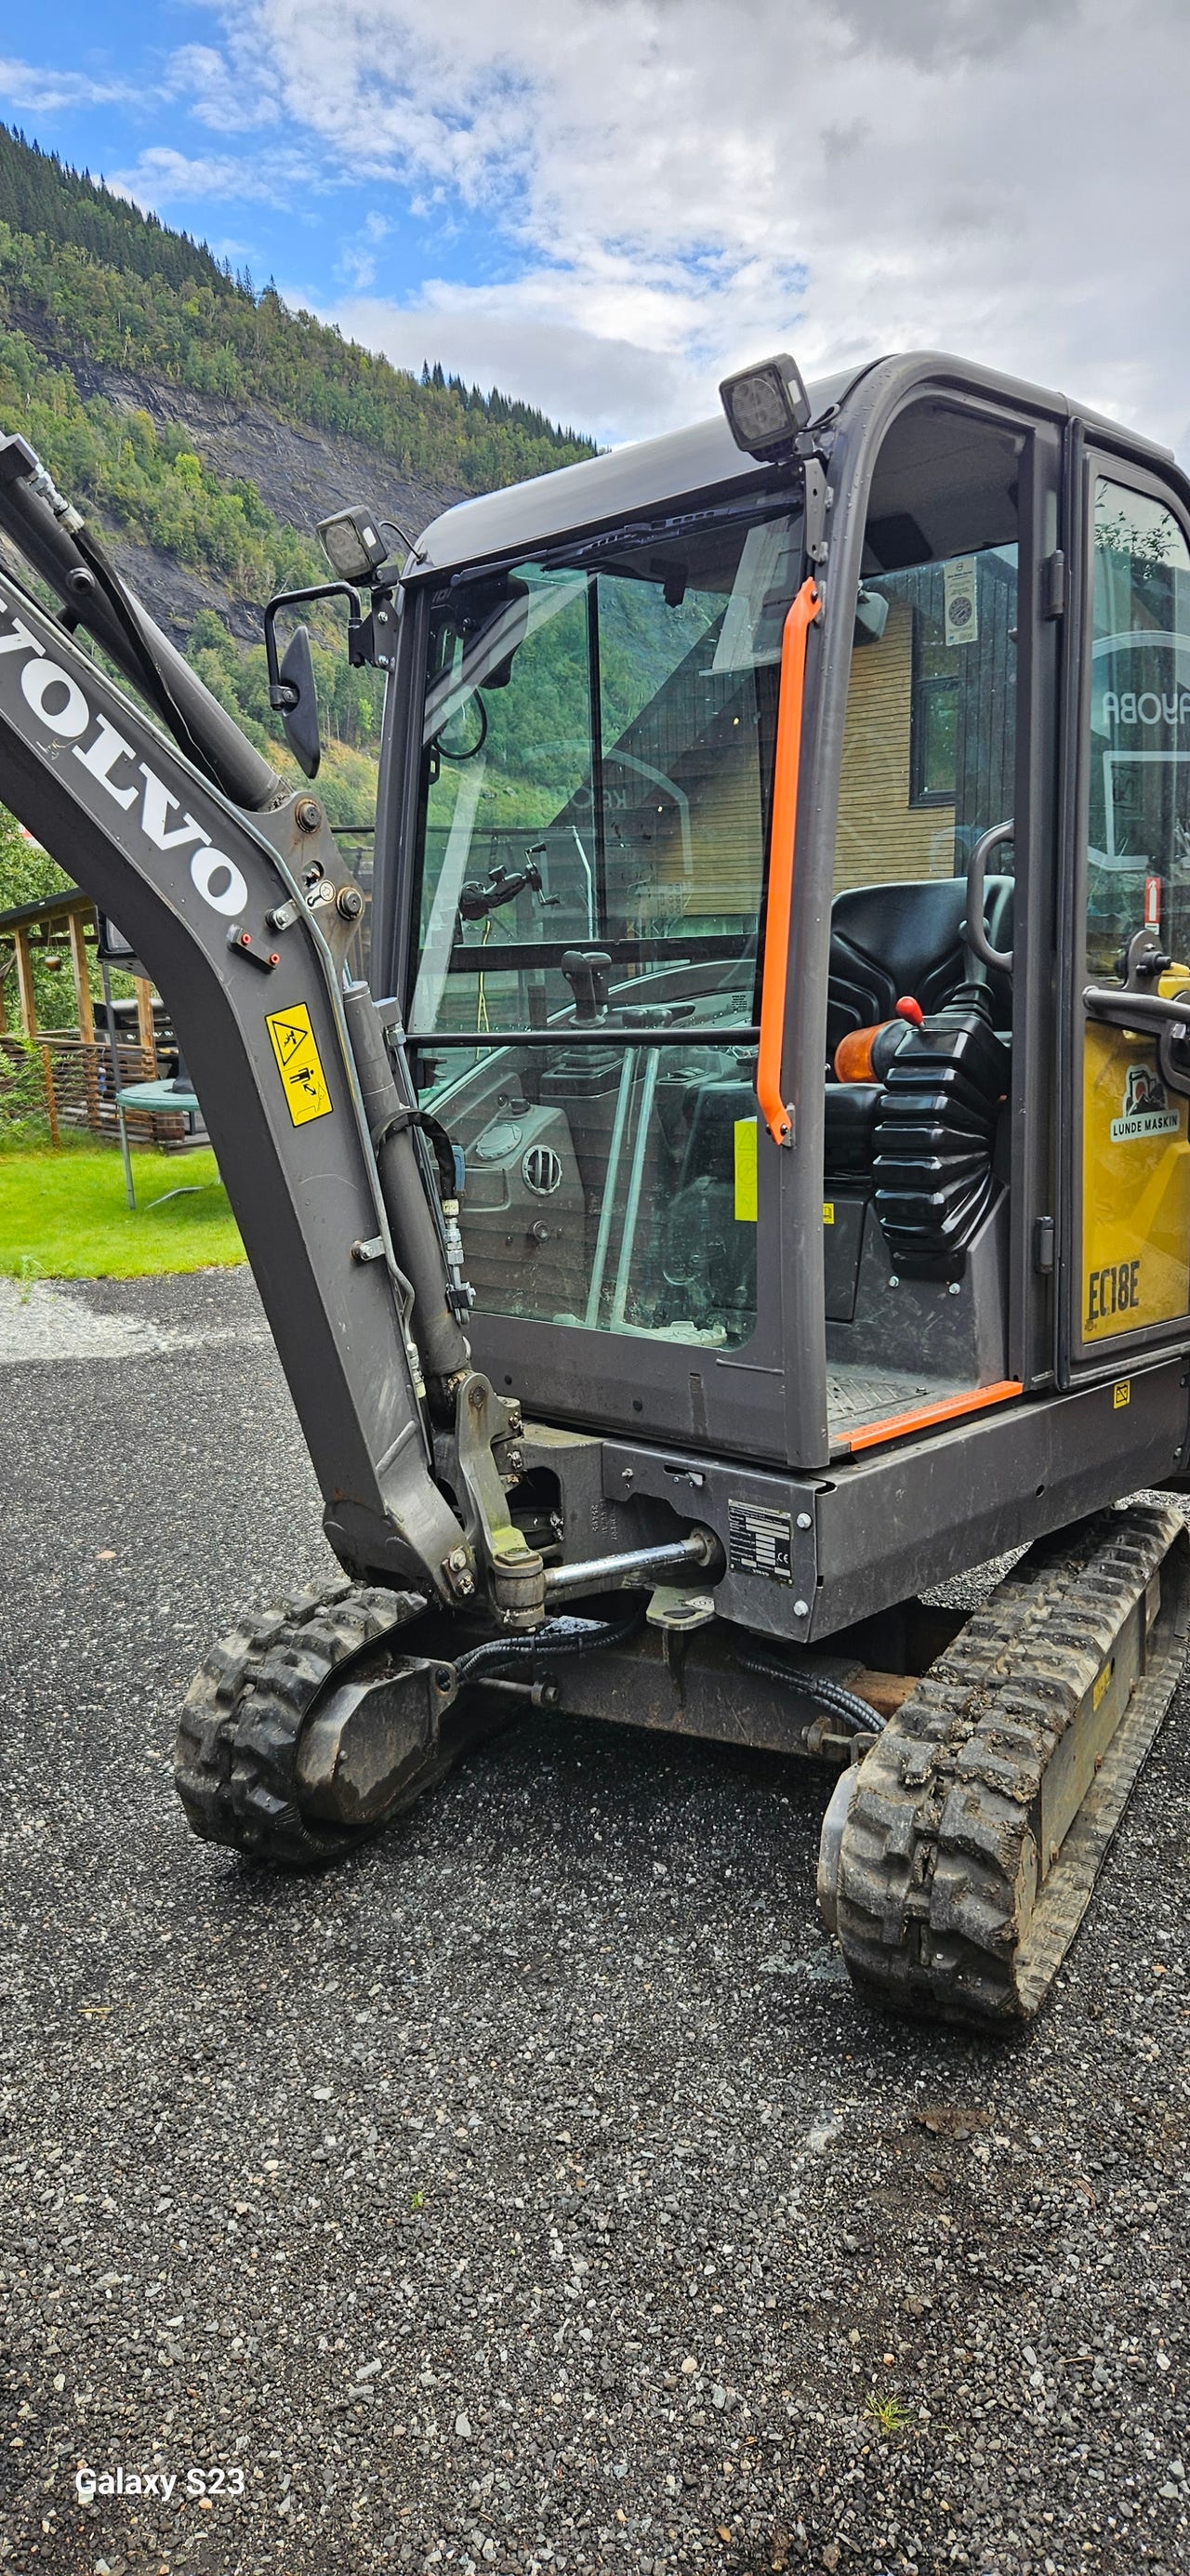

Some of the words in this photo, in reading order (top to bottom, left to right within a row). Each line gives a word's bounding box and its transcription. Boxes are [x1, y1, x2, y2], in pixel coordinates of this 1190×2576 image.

[1113, 1121, 1142, 1136] LUNDE
[1144, 1115, 1178, 1131] MASKIN
[1089, 1260, 1141, 1320] EC18E
